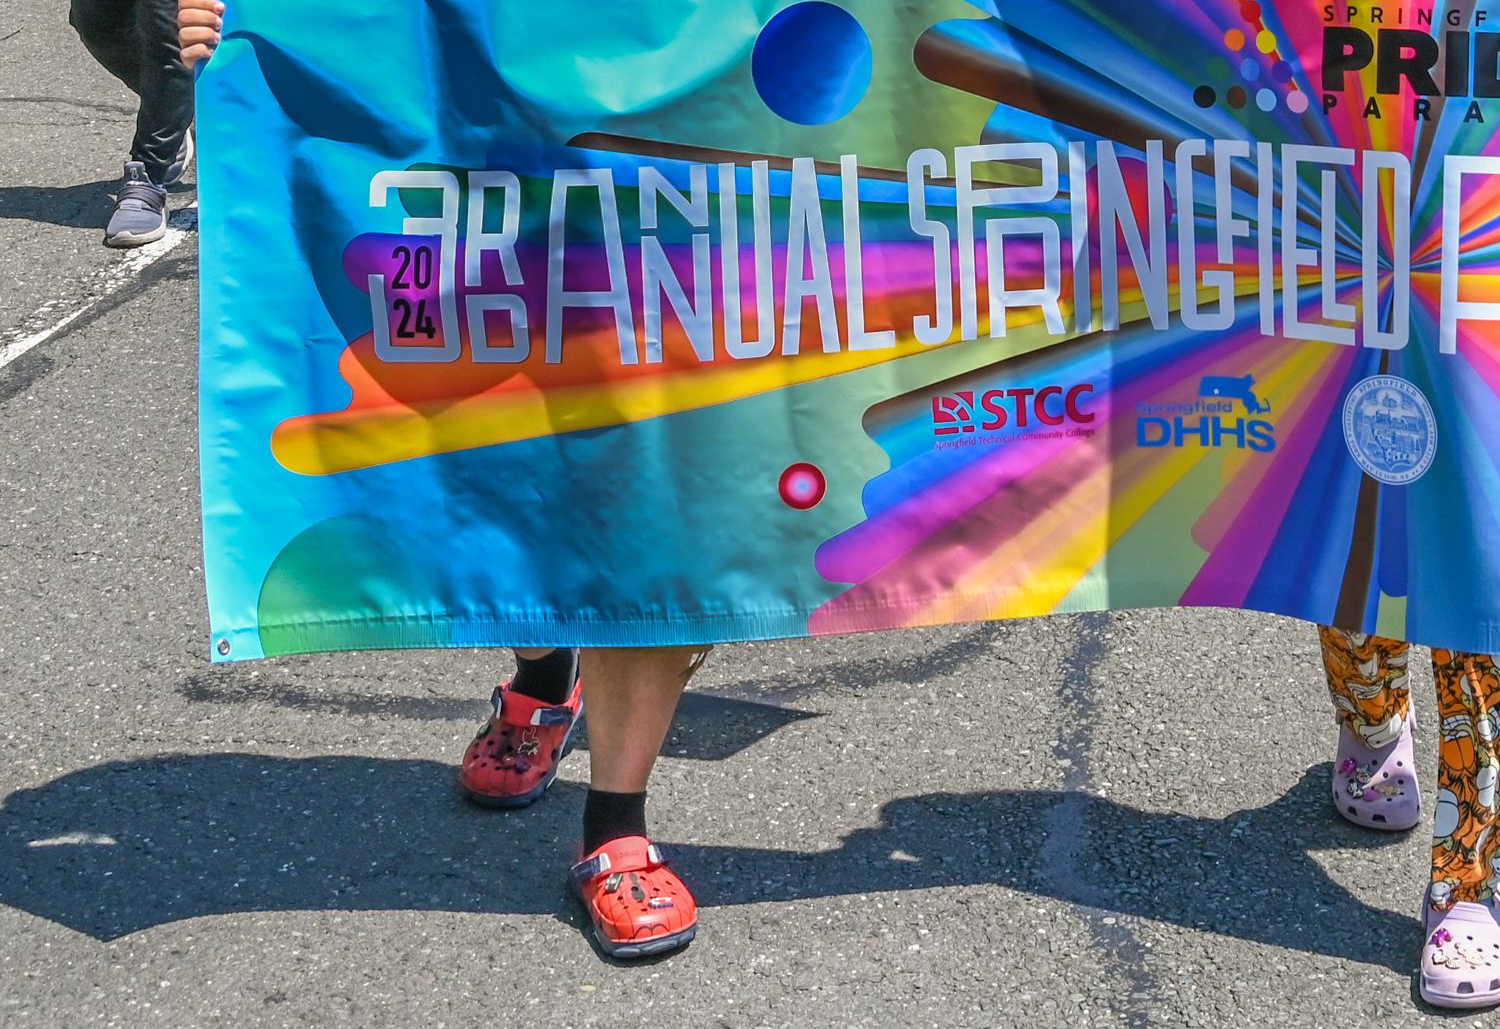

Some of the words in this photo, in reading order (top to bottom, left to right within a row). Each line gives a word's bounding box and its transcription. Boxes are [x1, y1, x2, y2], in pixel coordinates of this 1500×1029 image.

[391, 245, 432, 290] 20
[545, 154, 896, 365] ANNUAL
[906, 139, 1412, 351] SPRINGFIELD
[393, 298, 436, 339] 24
[981, 384, 1096, 431] STCC
[1359, 379, 1418, 397] SPRINGFIELD
[1136, 401, 1232, 415] Springfield
[935, 437, 976, 451] Springfield
[979, 434, 1015, 445] Technical
[1017, 430, 1063, 443] Community
[1065, 427, 1096, 439] College
[1136, 416, 1277, 453] DHHS
